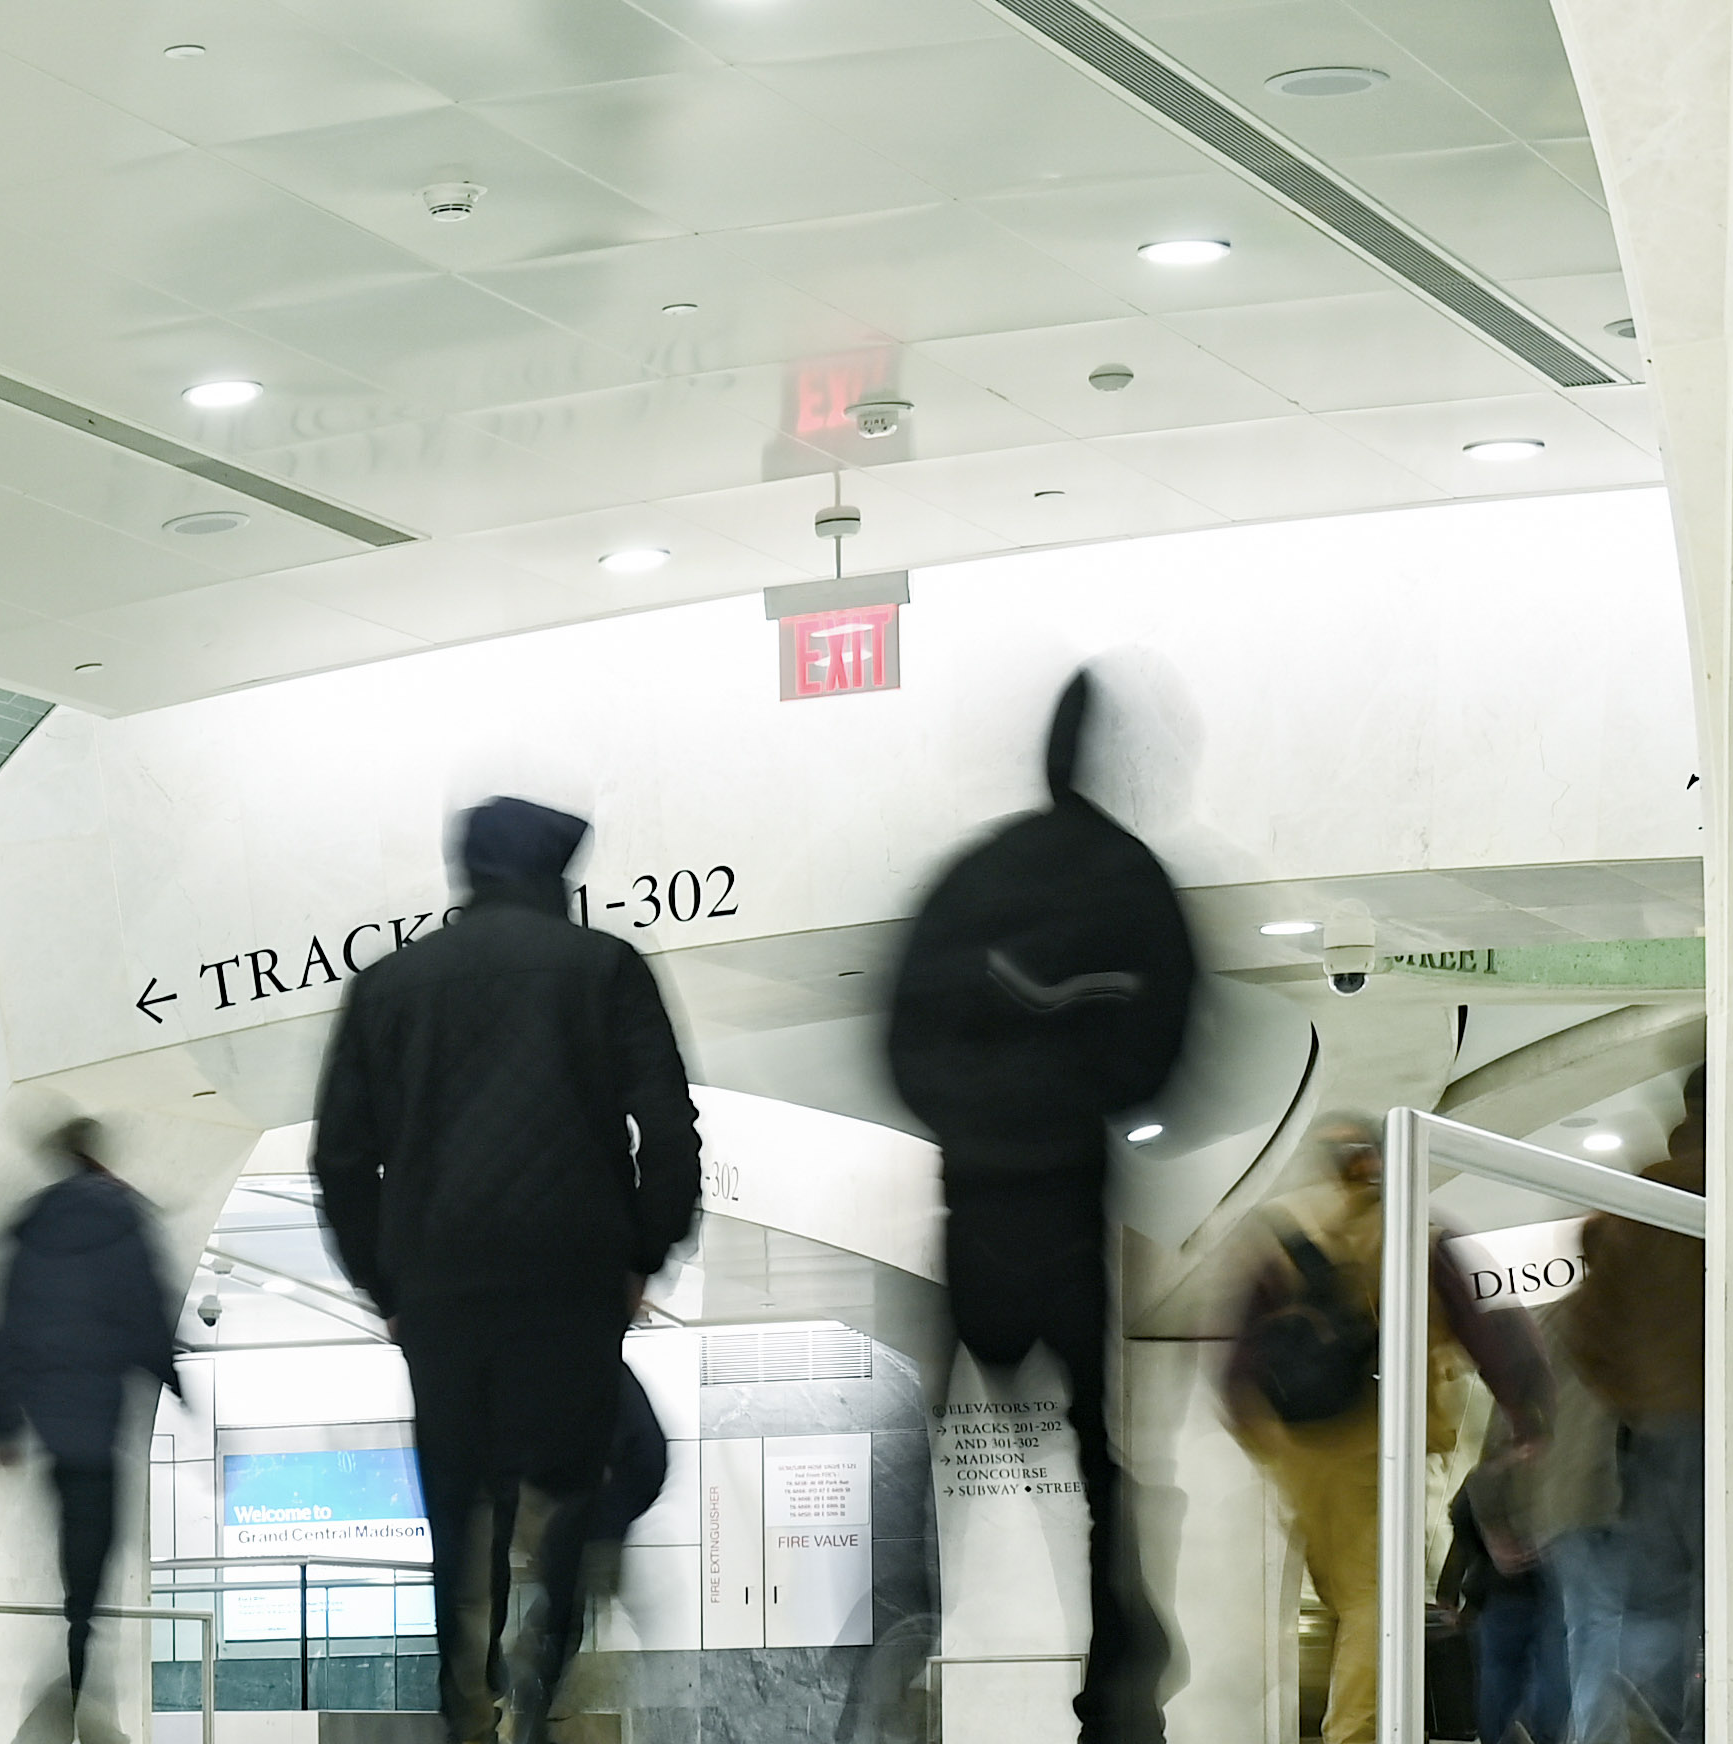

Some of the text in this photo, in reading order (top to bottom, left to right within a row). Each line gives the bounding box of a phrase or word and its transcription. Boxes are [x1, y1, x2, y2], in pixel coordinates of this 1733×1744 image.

[796, 610, 892, 696] EXIT
[199, 905, 462, 1011] TRACK
[948, 1400, 1059, 1415] ELEVATORS TO:
[951, 1420, 1063, 1435] TRACKS 201-202
[954, 1437, 1040, 1450] AND 301-302
[956, 1452, 1025, 1465] MADISON
[957, 1467, 1048, 1481] CONCOURSE
[958, 1484, 1019, 1497] SUBWAY
[233, 1504, 332, 1524] Welcome to
[238, 1524, 425, 1544] Grand Central Madison
[778, 1534, 859, 1548] FIRE VALVE
[709, 1486, 721, 1604] FIRE EXTINGUISHER
